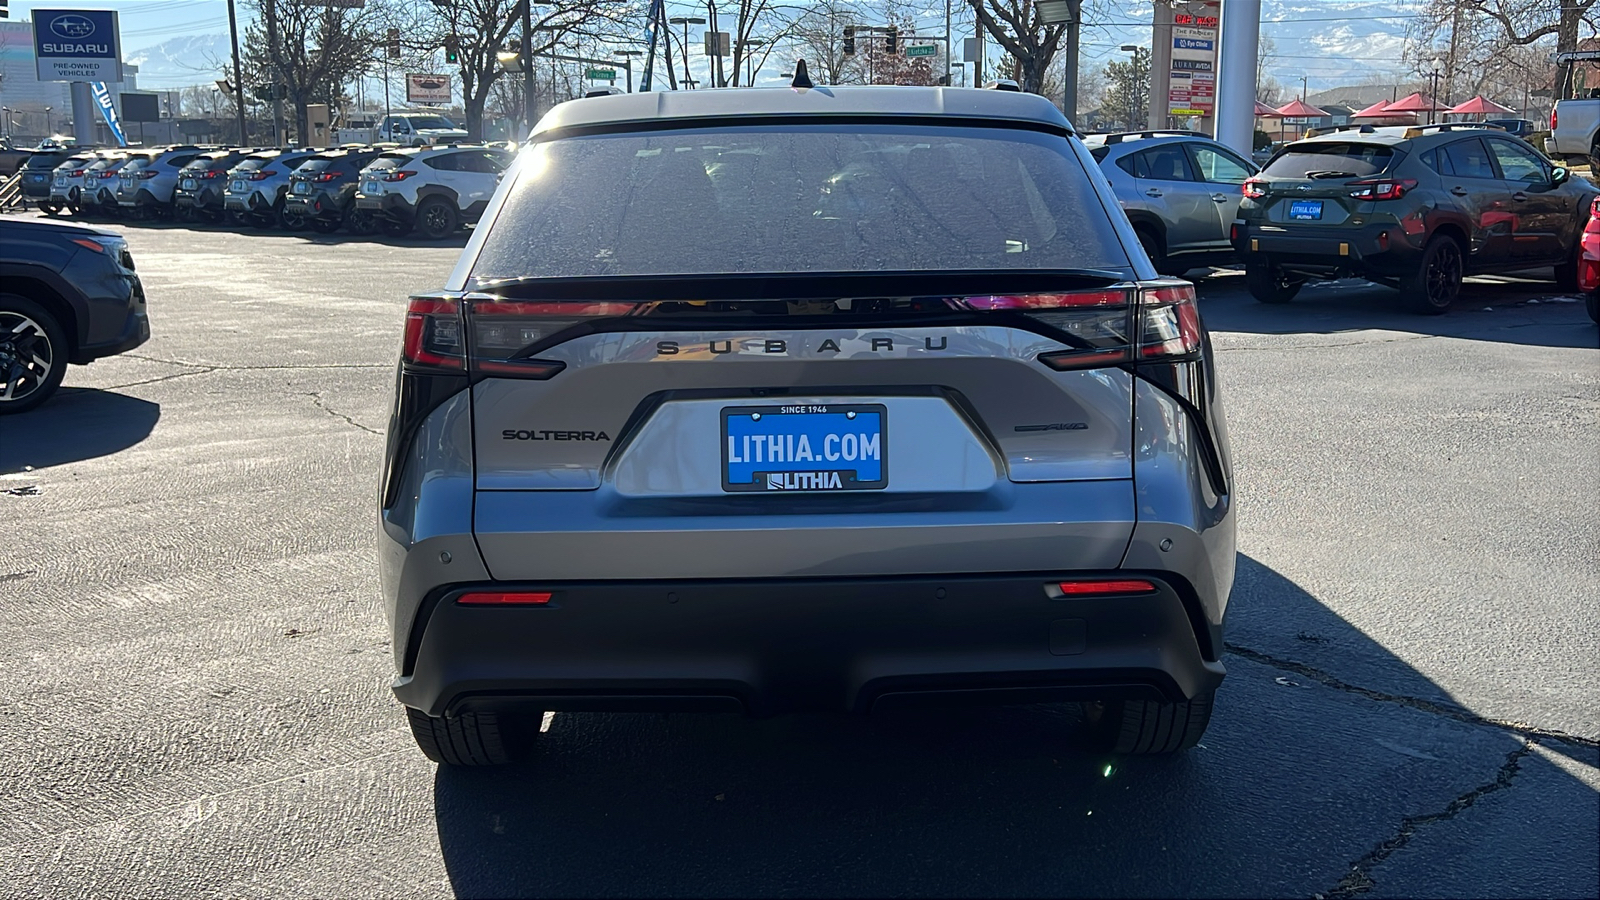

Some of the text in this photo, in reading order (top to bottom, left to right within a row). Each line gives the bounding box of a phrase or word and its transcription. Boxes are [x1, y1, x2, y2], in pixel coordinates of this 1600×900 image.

[43, 43, 108, 53] SUBARU
[1290, 206, 1321, 214] LITHIA.COM
[656, 336, 948, 355] SUBARU
[780, 405, 827, 414] SINCE 1946
[502, 429, 610, 441] SOLTERRA
[728, 432, 880, 463] LITHIA.COM
[784, 471, 843, 490] LITHIA
